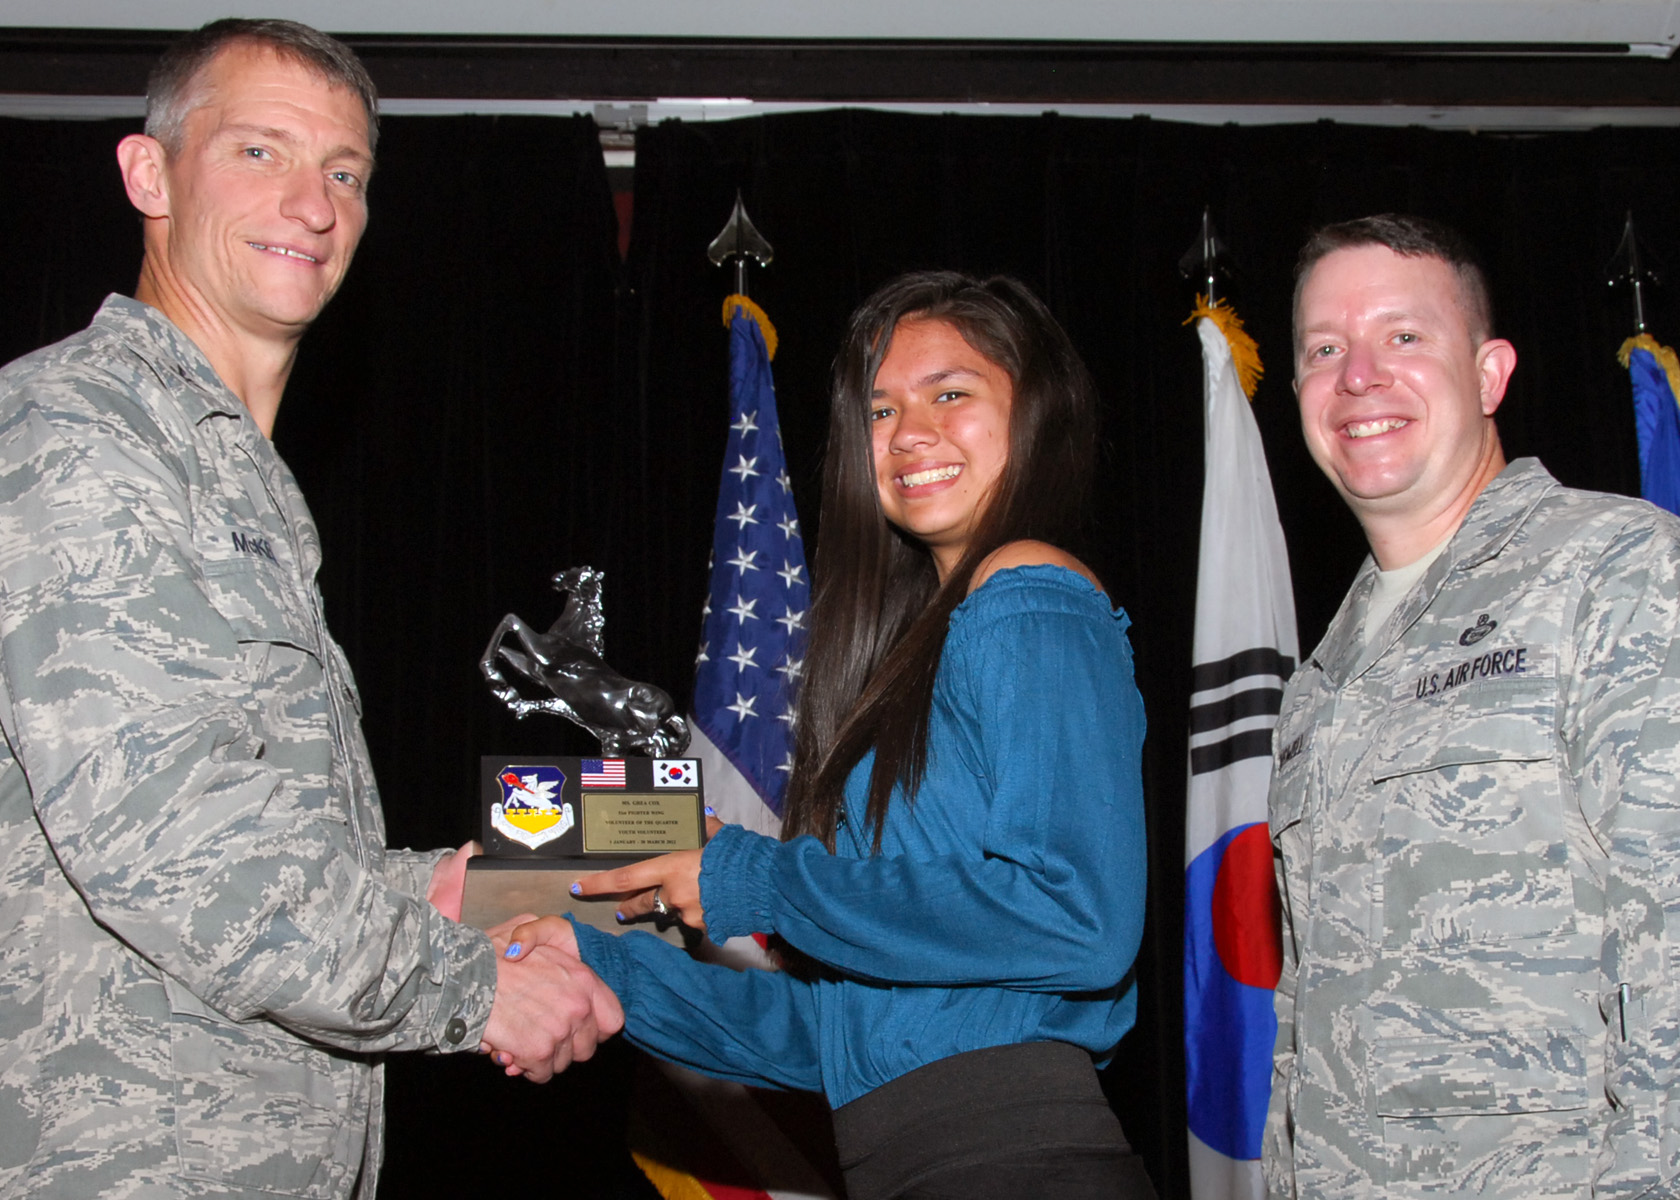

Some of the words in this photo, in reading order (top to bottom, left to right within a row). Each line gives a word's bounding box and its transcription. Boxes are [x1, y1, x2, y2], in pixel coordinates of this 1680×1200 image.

[1416, 672, 1440, 699] U.S.
[1443, 662, 1470, 690] AIR
[1471, 648, 1527, 679] FORCE
